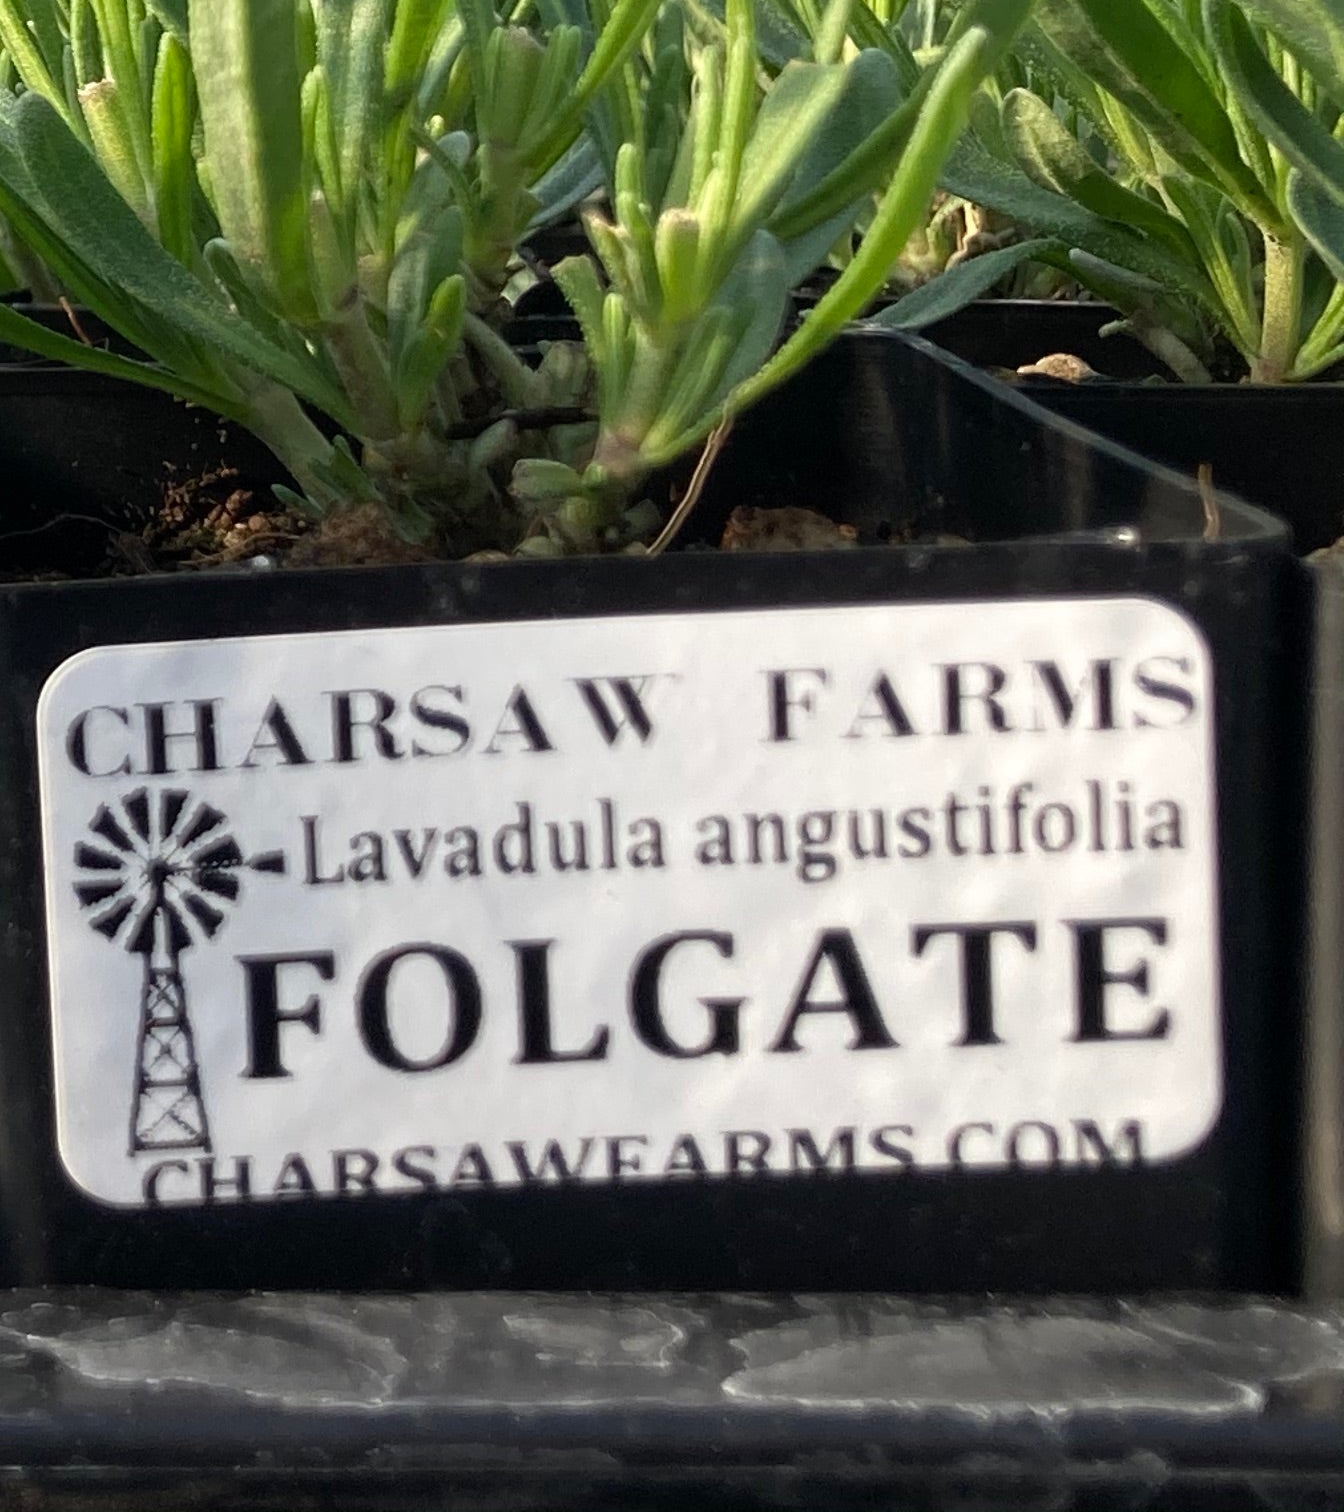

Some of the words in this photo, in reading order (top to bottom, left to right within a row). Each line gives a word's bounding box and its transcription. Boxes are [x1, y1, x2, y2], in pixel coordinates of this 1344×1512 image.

[64, 670, 678, 778] CHARSAW
[763, 655, 1198, 744] FARMS
[300, 796, 666, 888] Lavadula
[694, 779, 1186, 880] angustifolia
[236, 917, 1173, 1080] FOLGATE
[141, 1119, 1145, 1204] CHARSAWFARMSCOM
